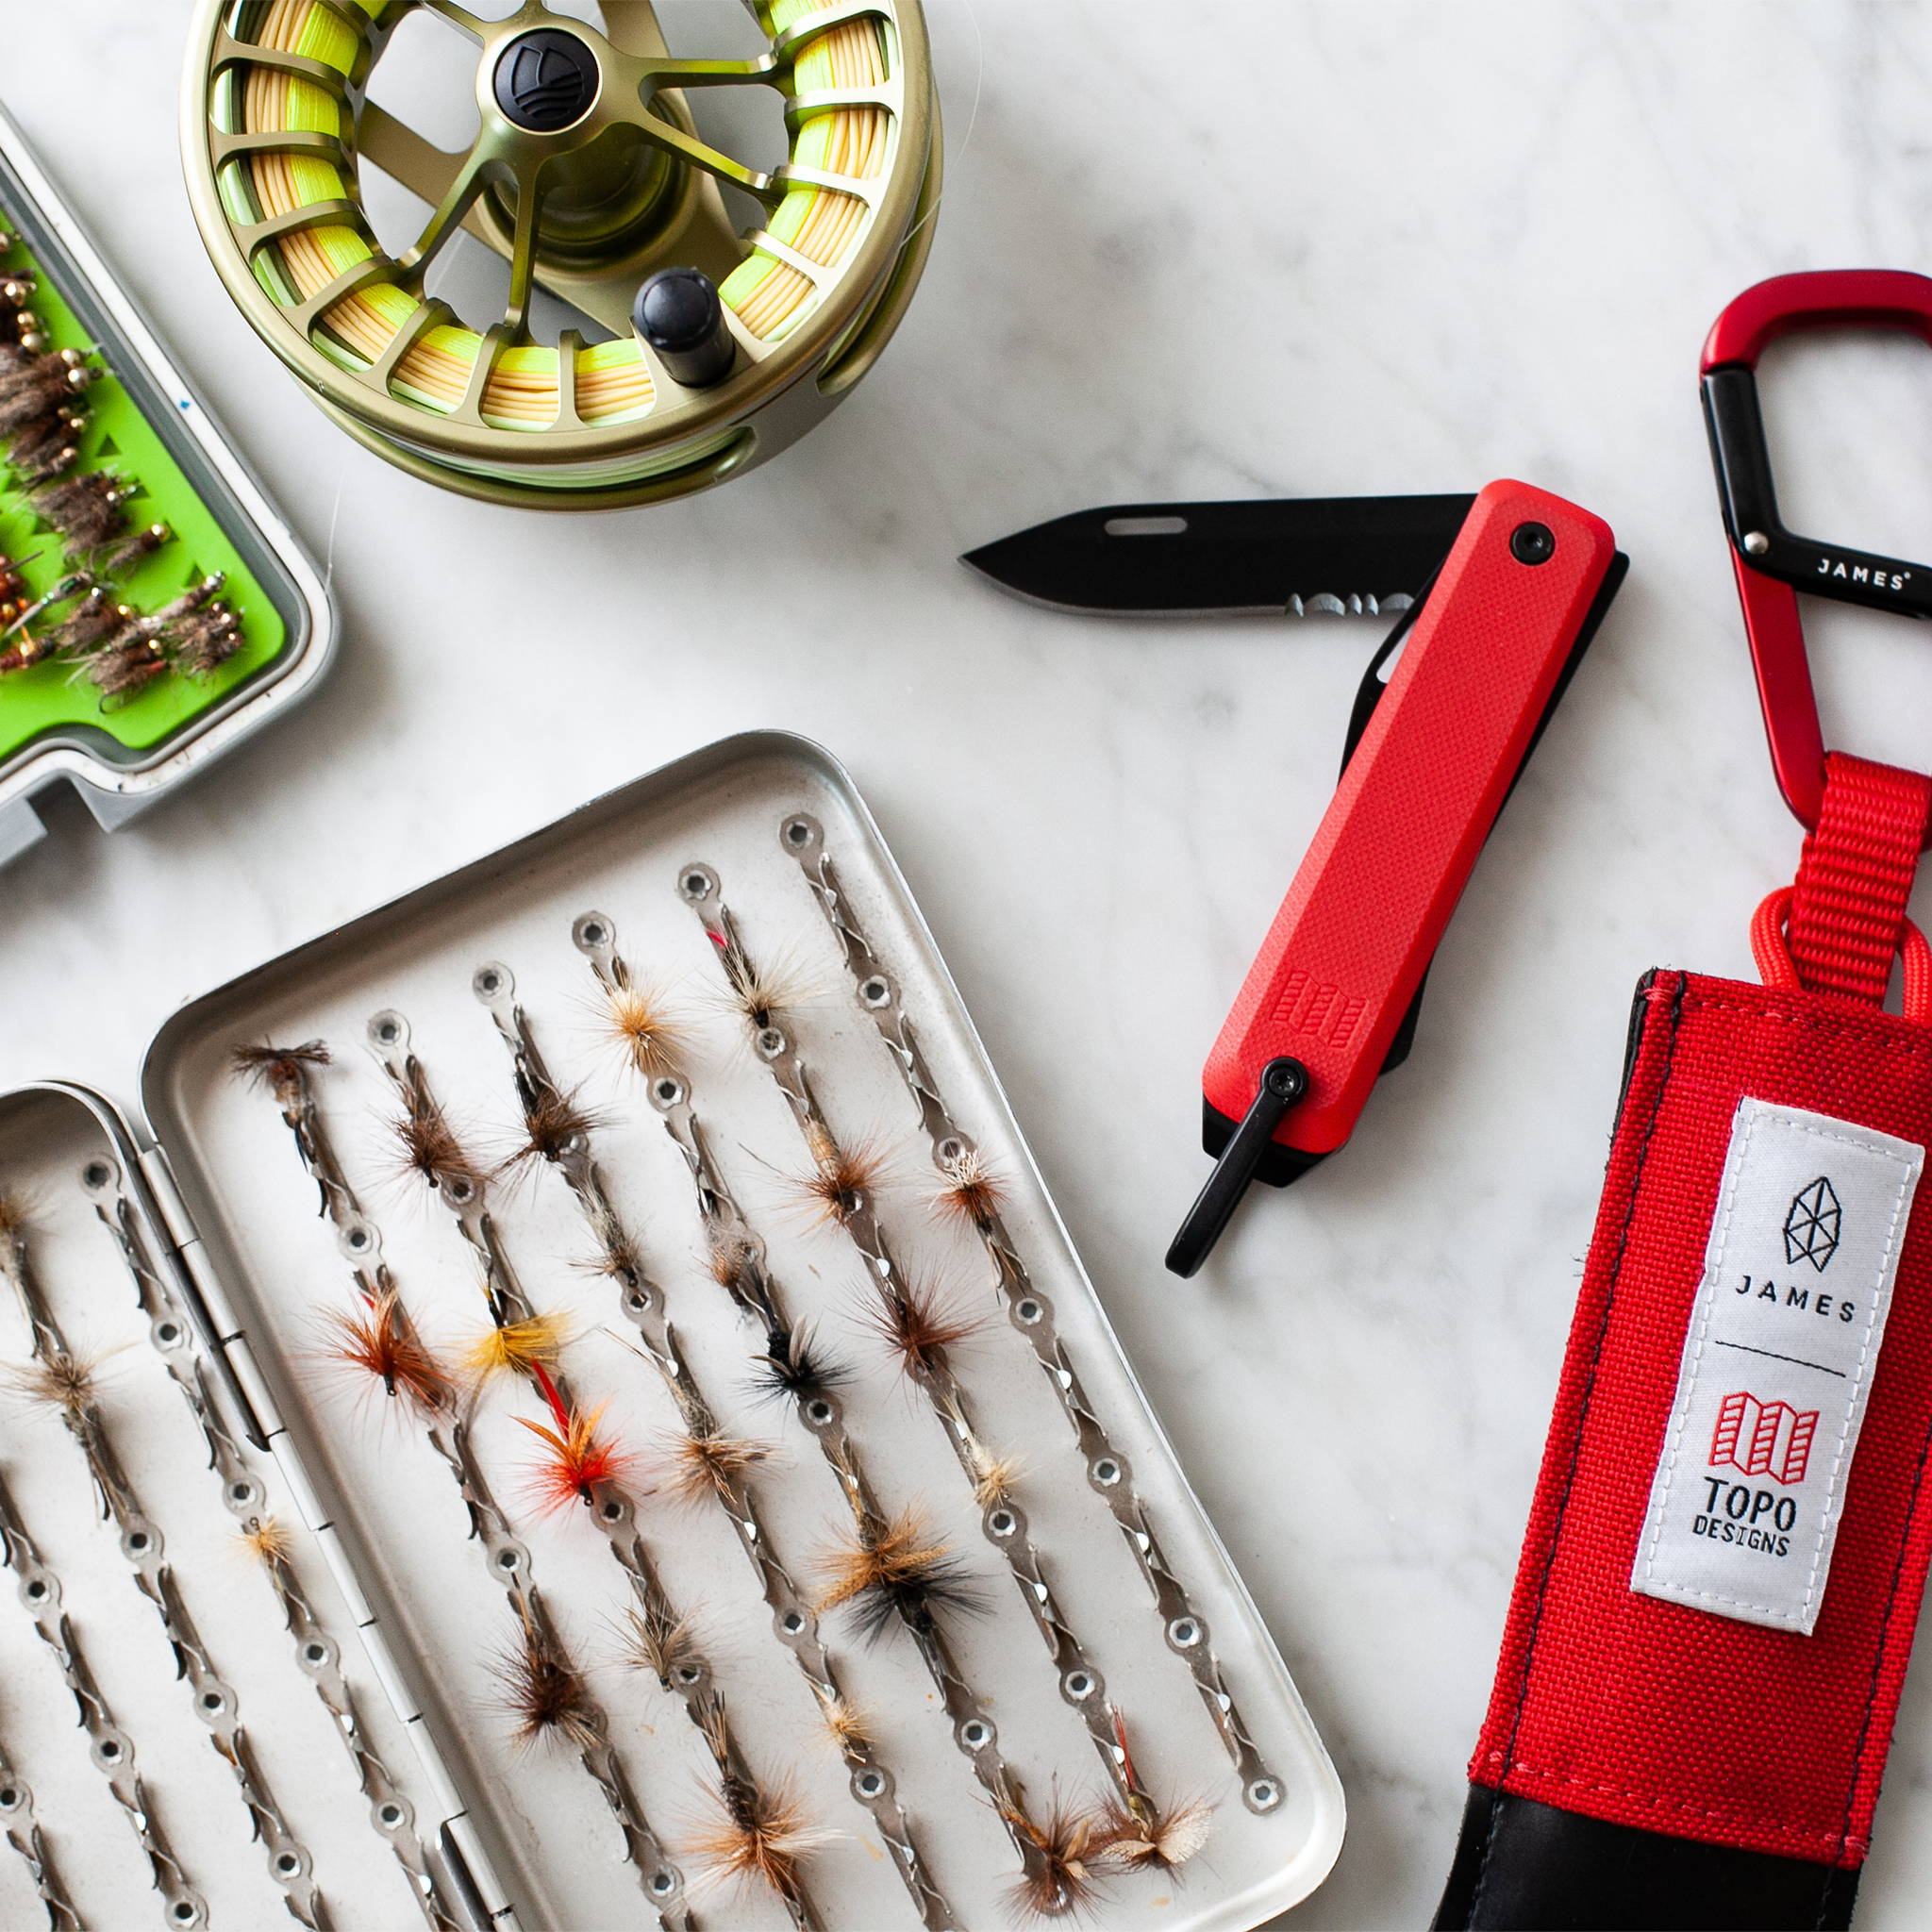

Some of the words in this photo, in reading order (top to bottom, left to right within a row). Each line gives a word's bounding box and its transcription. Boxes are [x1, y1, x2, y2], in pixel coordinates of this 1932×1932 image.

[1817, 558, 1903, 591] JAMES
[1735, 1274, 1856, 1323] JAMES
[1704, 1475, 1797, 1532] TOPO
[1692, 1514, 1790, 1557] DESIGNS
